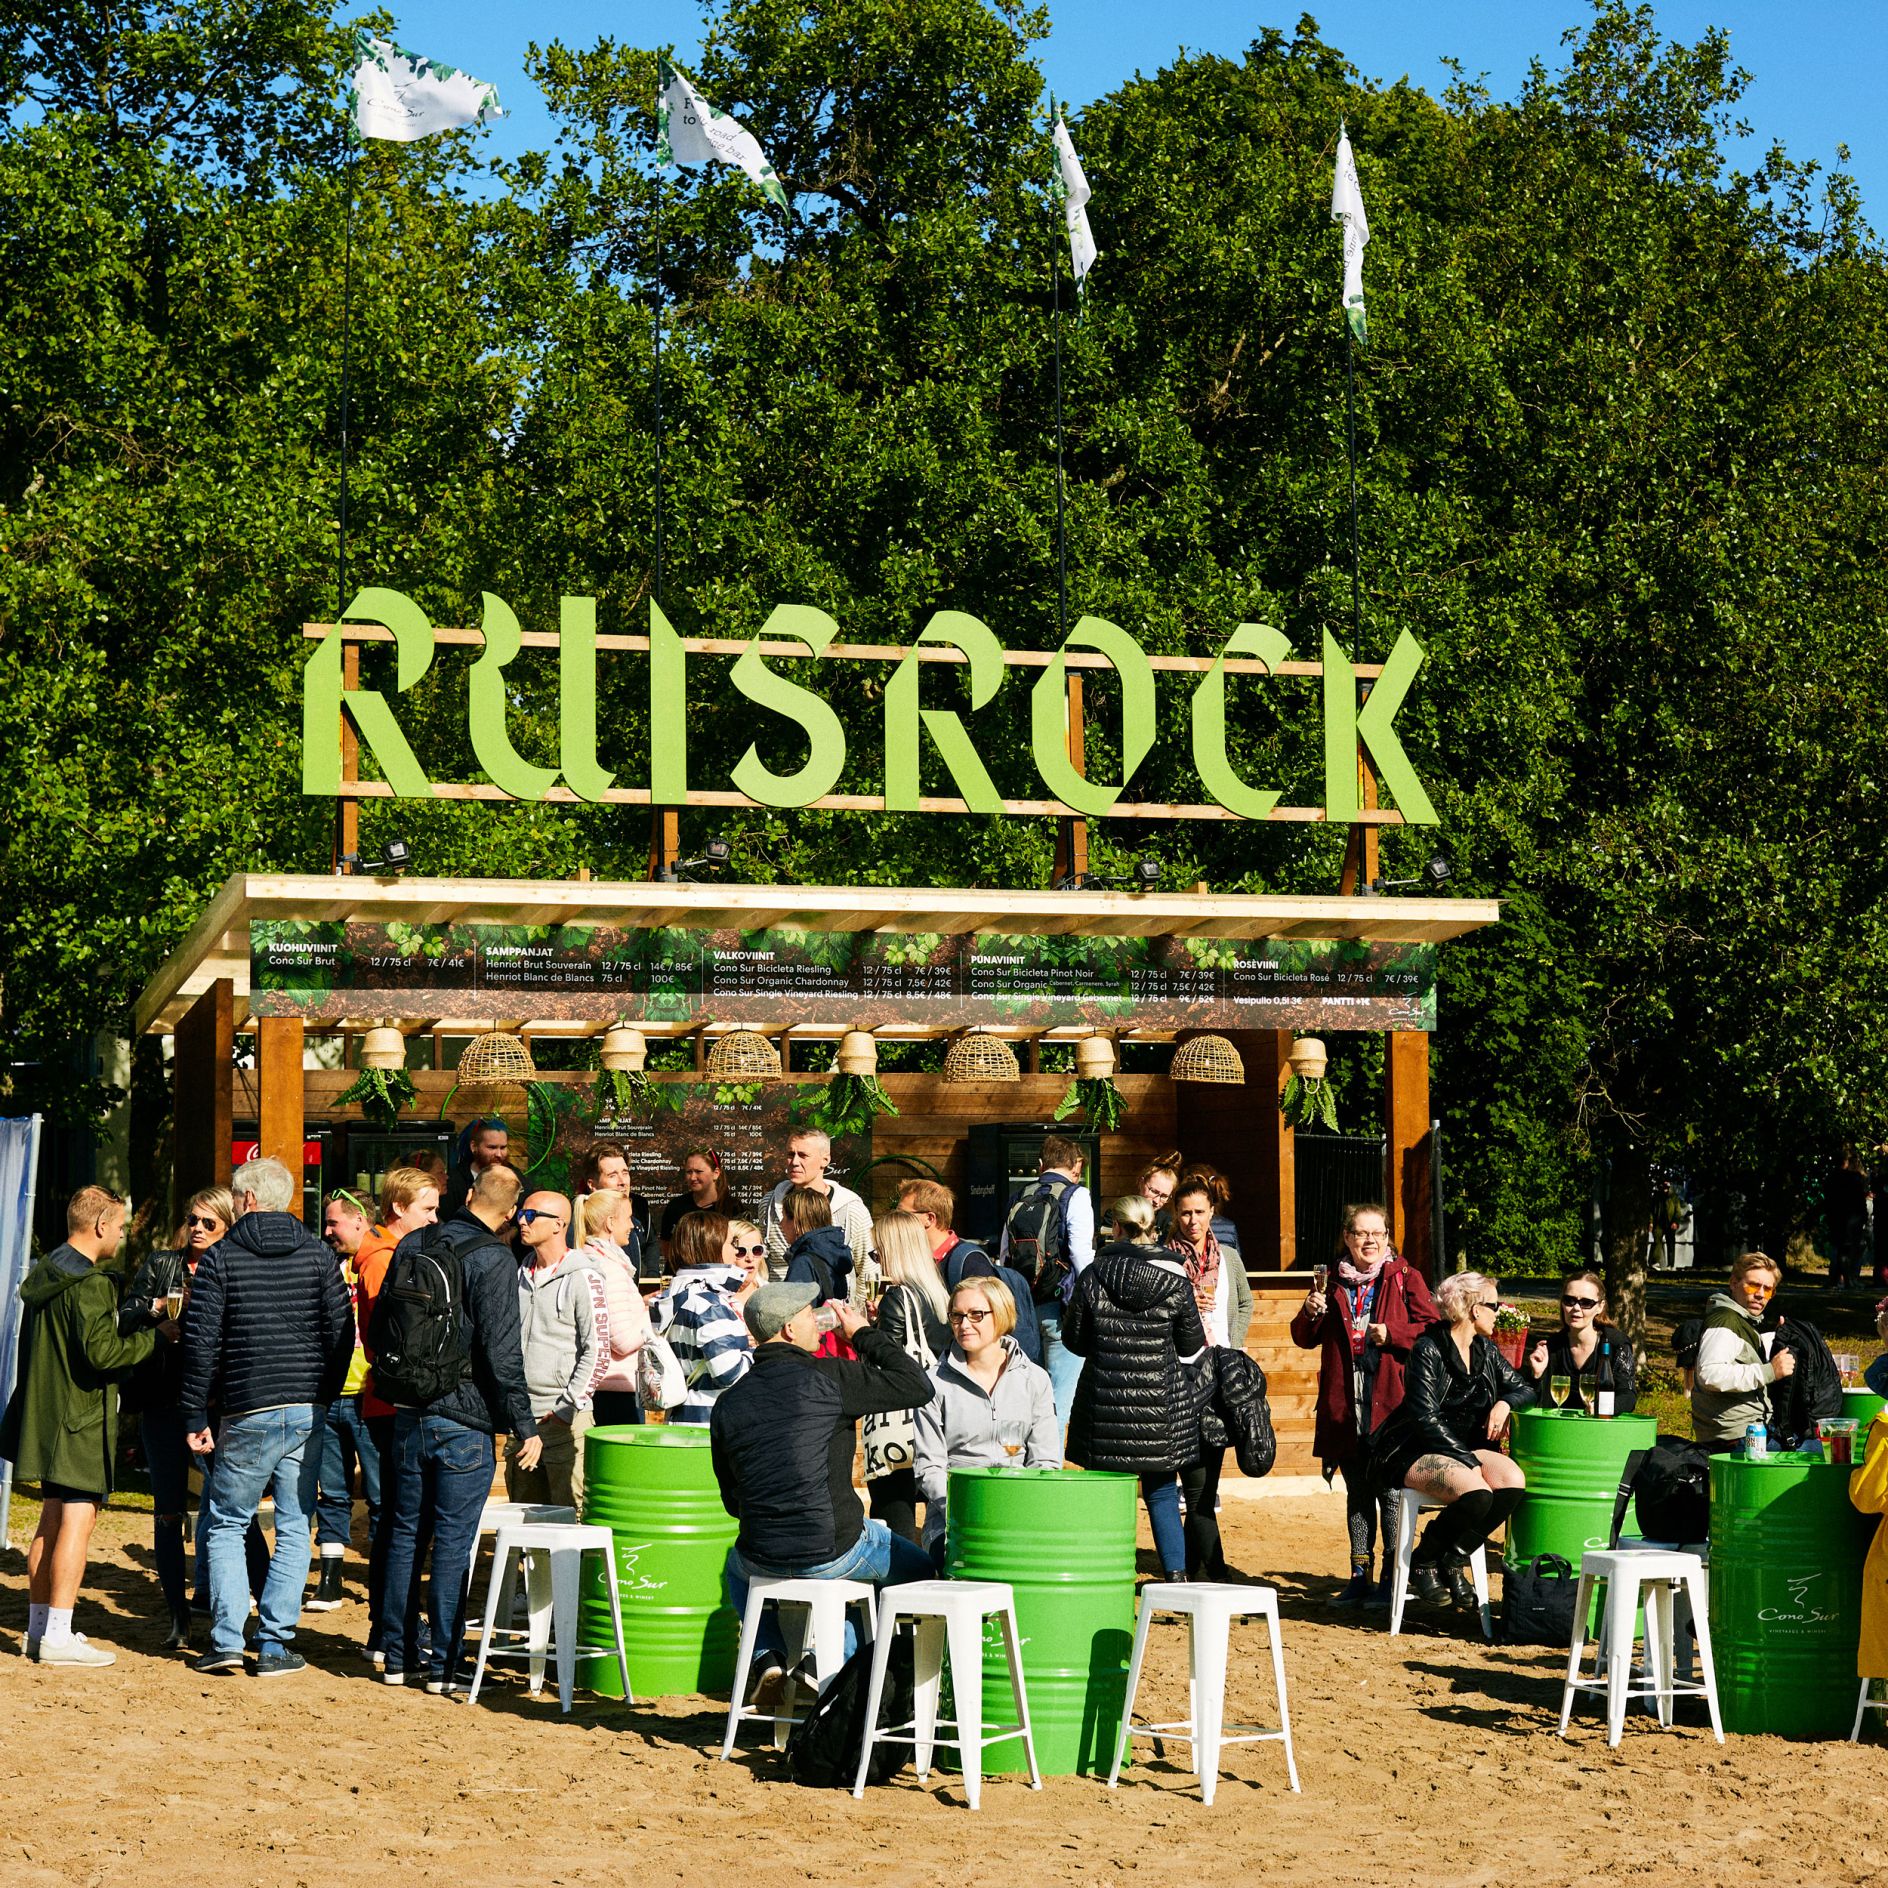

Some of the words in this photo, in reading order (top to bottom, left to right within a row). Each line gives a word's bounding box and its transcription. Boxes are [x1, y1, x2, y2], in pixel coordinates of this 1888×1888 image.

[683, 115, 696, 125] to
[302, 586, 1440, 826] RUISROCK
[269, 944, 337, 953] KUOHUVIINIT
[486, 947, 553, 957] SAMPPANJAT
[713, 952, 775, 961] VALKOVIINIT
[971, 956, 1025, 965] PUNAVIINIT
[269, 957, 294, 965] Cono
[297, 957, 313, 965] Sur
[316, 957, 335, 966] Brut
[371, 958, 380, 967] 12
[382, 958, 388, 967] /
[390, 958, 401, 967] 75
[403, 958, 411, 967] cl
[428, 959, 440, 968] 7€
[441, 959, 448, 968] /
[450, 959, 464, 968] 41€
[486, 960, 521, 969] Henriot
[524, 961, 544, 970] Brut
[546, 961, 592, 970] Souverain
[602, 962, 610, 971] 12
[613, 962, 618, 971] /
[620, 962, 632, 971] 75
[634, 962, 641, 971] cl
[650, 963, 665, 971] 14€
[667, 963, 673, 971] /
[675, 963, 692, 972] 85€
[714, 964, 737, 973] Cono
[740, 964, 755, 973] Sur
[758, 965, 794, 973] Bicicleta
[796, 965, 831, 976] Riesling
[864, 966, 872, 975] 12
[874, 966, 880, 975] /
[882, 966, 892, 975] 75
[894, 966, 902, 975] cl
[914, 967, 926, 976] 7€
[927, 967, 932, 976] /
[934, 967, 952, 976] 39€
[972, 968, 994, 977] Cono
[997, 968, 1011, 977] Sur
[1013, 969, 1048, 977] Bicicleta
[1051, 969, 1072, 977] Pinot
[1075, 969, 1094, 978] Noir
[1130, 971, 1140, 979] 12
[1141, 971, 1146, 979] /
[1148, 971, 1158, 979] 75
[1160, 971, 1167, 979] cl
[1180, 971, 1190, 980] 7€
[1192, 971, 1196, 980] /
[1199, 971, 1215, 980] 39€
[486, 972, 521, 981] Henriot
[524, 973, 548, 982] Blanc
[551, 973, 562, 982] de
[565, 973, 594, 982] Blancs
[602, 974, 614, 983] 75
[616, 974, 622, 983] cl
[652, 975, 674, 984] 100€
[1234, 973, 1256, 981] Cono
[1258, 973, 1272, 981] Sur
[1310, 974, 1330, 982] Rosé
[1354, 975, 1364, 983] 75
[1366, 975, 1372, 983] cl
[1385, 975, 1395, 983] 7€
[1396, 975, 1401, 983] /
[1403, 975, 1418, 983] 39€
[714, 976, 737, 985] Cono
[740, 976, 755, 985] Sur
[758, 977, 792, 987] Organic
[795, 977, 849, 988] Chardonnay
[864, 978, 872, 987] 12
[874, 978, 880, 987] /
[882, 978, 892, 987] 75
[894, 978, 902, 987] cl
[908, 979, 926, 989] 7,5€
[927, 979, 932, 988] /
[934, 979, 952, 988] 42€
[972, 980, 994, 988] Cono
[997, 980, 1011, 989] Sur
[1013, 980, 1047, 991] Organic
[1130, 983, 1140, 991] 12
[1141, 983, 1146, 991] /
[1148, 983, 1158, 991] 75
[1160, 983, 1167, 991] cl
[1172, 983, 1190, 993] 7,5€
[1192, 983, 1196, 992] /
[1199, 983, 1215, 992] 42€
[714, 988, 737, 997] Cono
[739, 989, 754, 997] Sur
[756, 989, 782, 999] Single
[784, 989, 822, 1000] Vineyard
[825, 989, 858, 1000] Riesling
[864, 990, 872, 999] 12
[874, 990, 880, 999] /
[882, 991, 892, 999] 75
[894, 991, 902, 999] cl
[906, 991, 926, 1001] 8,5€
[927, 991, 932, 1000] /
[934, 991, 952, 1000] 48€
[972, 992, 994, 1000] Cono
[996, 992, 1010, 1001] Sur
[1013, 992, 1039, 1003] Single
[1041, 993, 1080, 1003] Vineyard
[1082, 993, 1122, 1002] Cabernet
[1130, 994, 1140, 1003] 12
[1141, 994, 1146, 1003] /
[1148, 994, 1158, 1003] 75
[1160, 994, 1167, 1003] cl
[1178, 995, 1190, 1003] 9€
[1192, 995, 1196, 1003] /
[1199, 995, 1215, 1003] 52€
[1234, 997, 1272, 1006] Vesipullo
[1274, 997, 1290, 1006] 0,5l
[1291, 997, 1302, 1005] 3€
[1322, 997, 1354, 1006] PANTTI
[1356, 998, 1370, 1006] +1€
[587, 1273, 607, 1309] JPN
[631, 1574, 668, 1590] Sur
[1757, 1607, 1804, 1621] Cono
[1801, 1606, 1839, 1624] Sur
